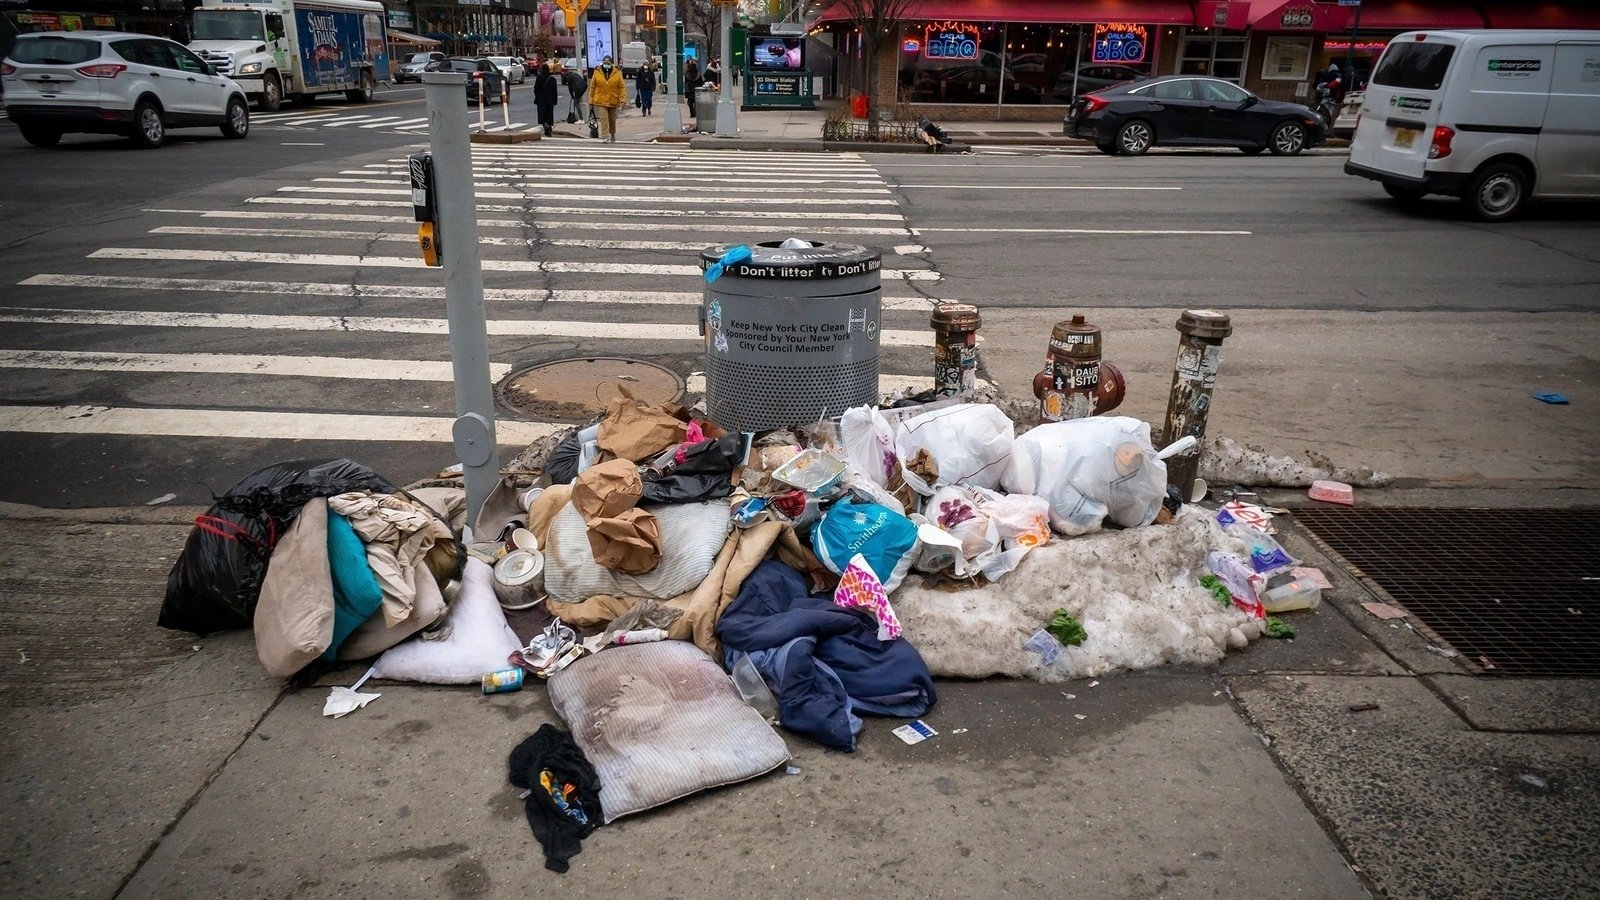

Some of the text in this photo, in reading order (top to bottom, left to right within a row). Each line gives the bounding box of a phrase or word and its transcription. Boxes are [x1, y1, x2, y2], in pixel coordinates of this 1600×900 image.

[308, 12, 338, 32] SAMUEL
[1283, 13, 1312, 25] BBQ
[313, 30, 338, 50] ADAMS
[1107, 32, 1135, 40] DALLAS
[927, 40, 977, 59] BBQ
[1095, 40, 1144, 61] BBQ
[740, 260, 881, 277] Don't litter Don't litter
[730, 319, 845, 334] Keep New York City Clean
[725, 328, 851, 344] Sponsored by Your New York
[739, 340, 835, 353] City Council Member
[1075, 375, 1098, 386] SITO
